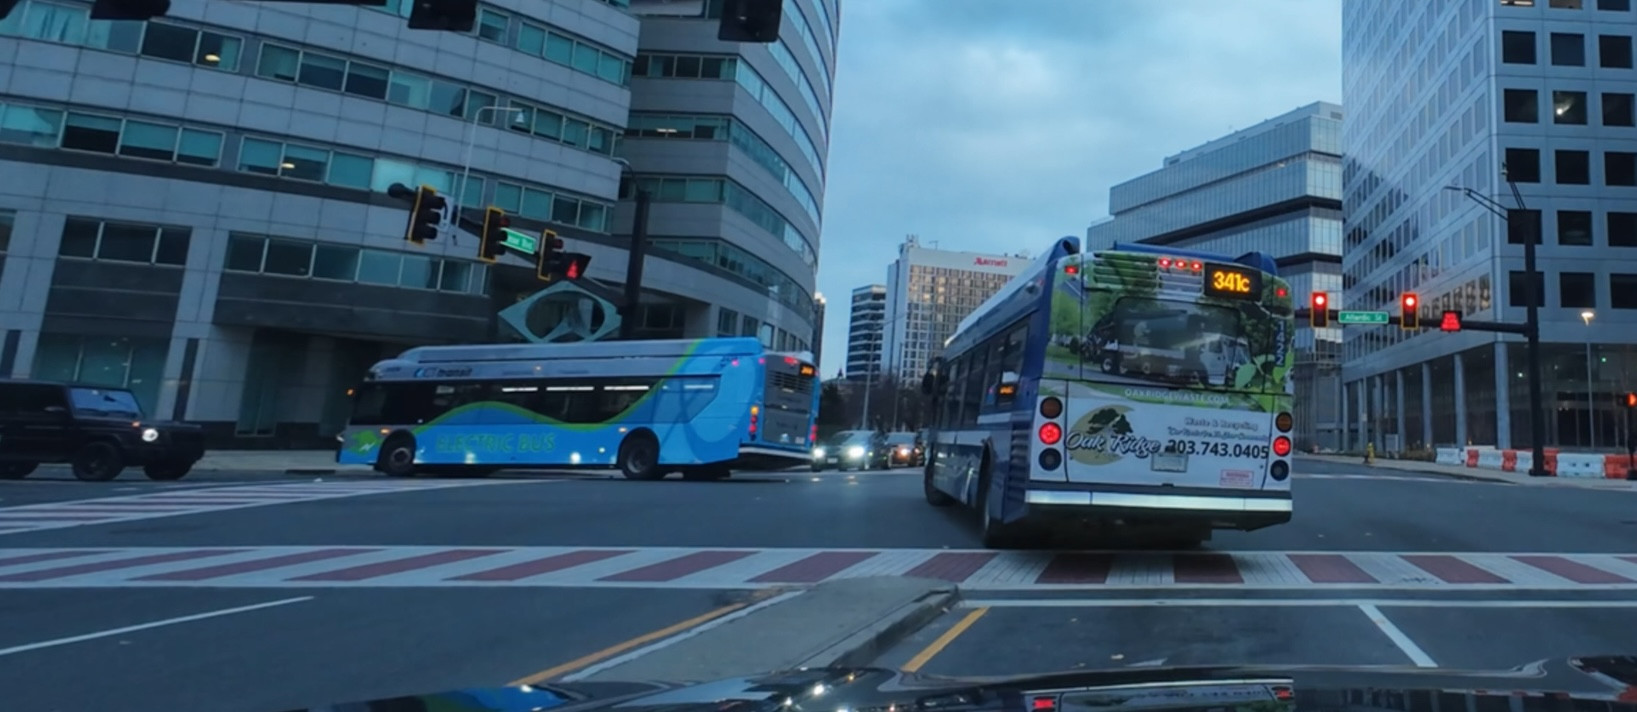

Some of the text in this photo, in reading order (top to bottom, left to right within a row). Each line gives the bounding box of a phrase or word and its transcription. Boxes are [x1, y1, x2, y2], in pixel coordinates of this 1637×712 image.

[1213, 271, 1250, 292] 341c
[1345, 311, 1371, 321] Atlantic
[1276, 320, 1285, 366] 1422
[1124, 388, 1231, 404] OAKRIDGEWASTE.COM
[1220, 420, 1258, 432] Recycling
[436, 433, 556, 453] ELECTRIC BUS
[1065, 431, 1106, 452] Oak
[1110, 434, 1161, 459] Ridge
